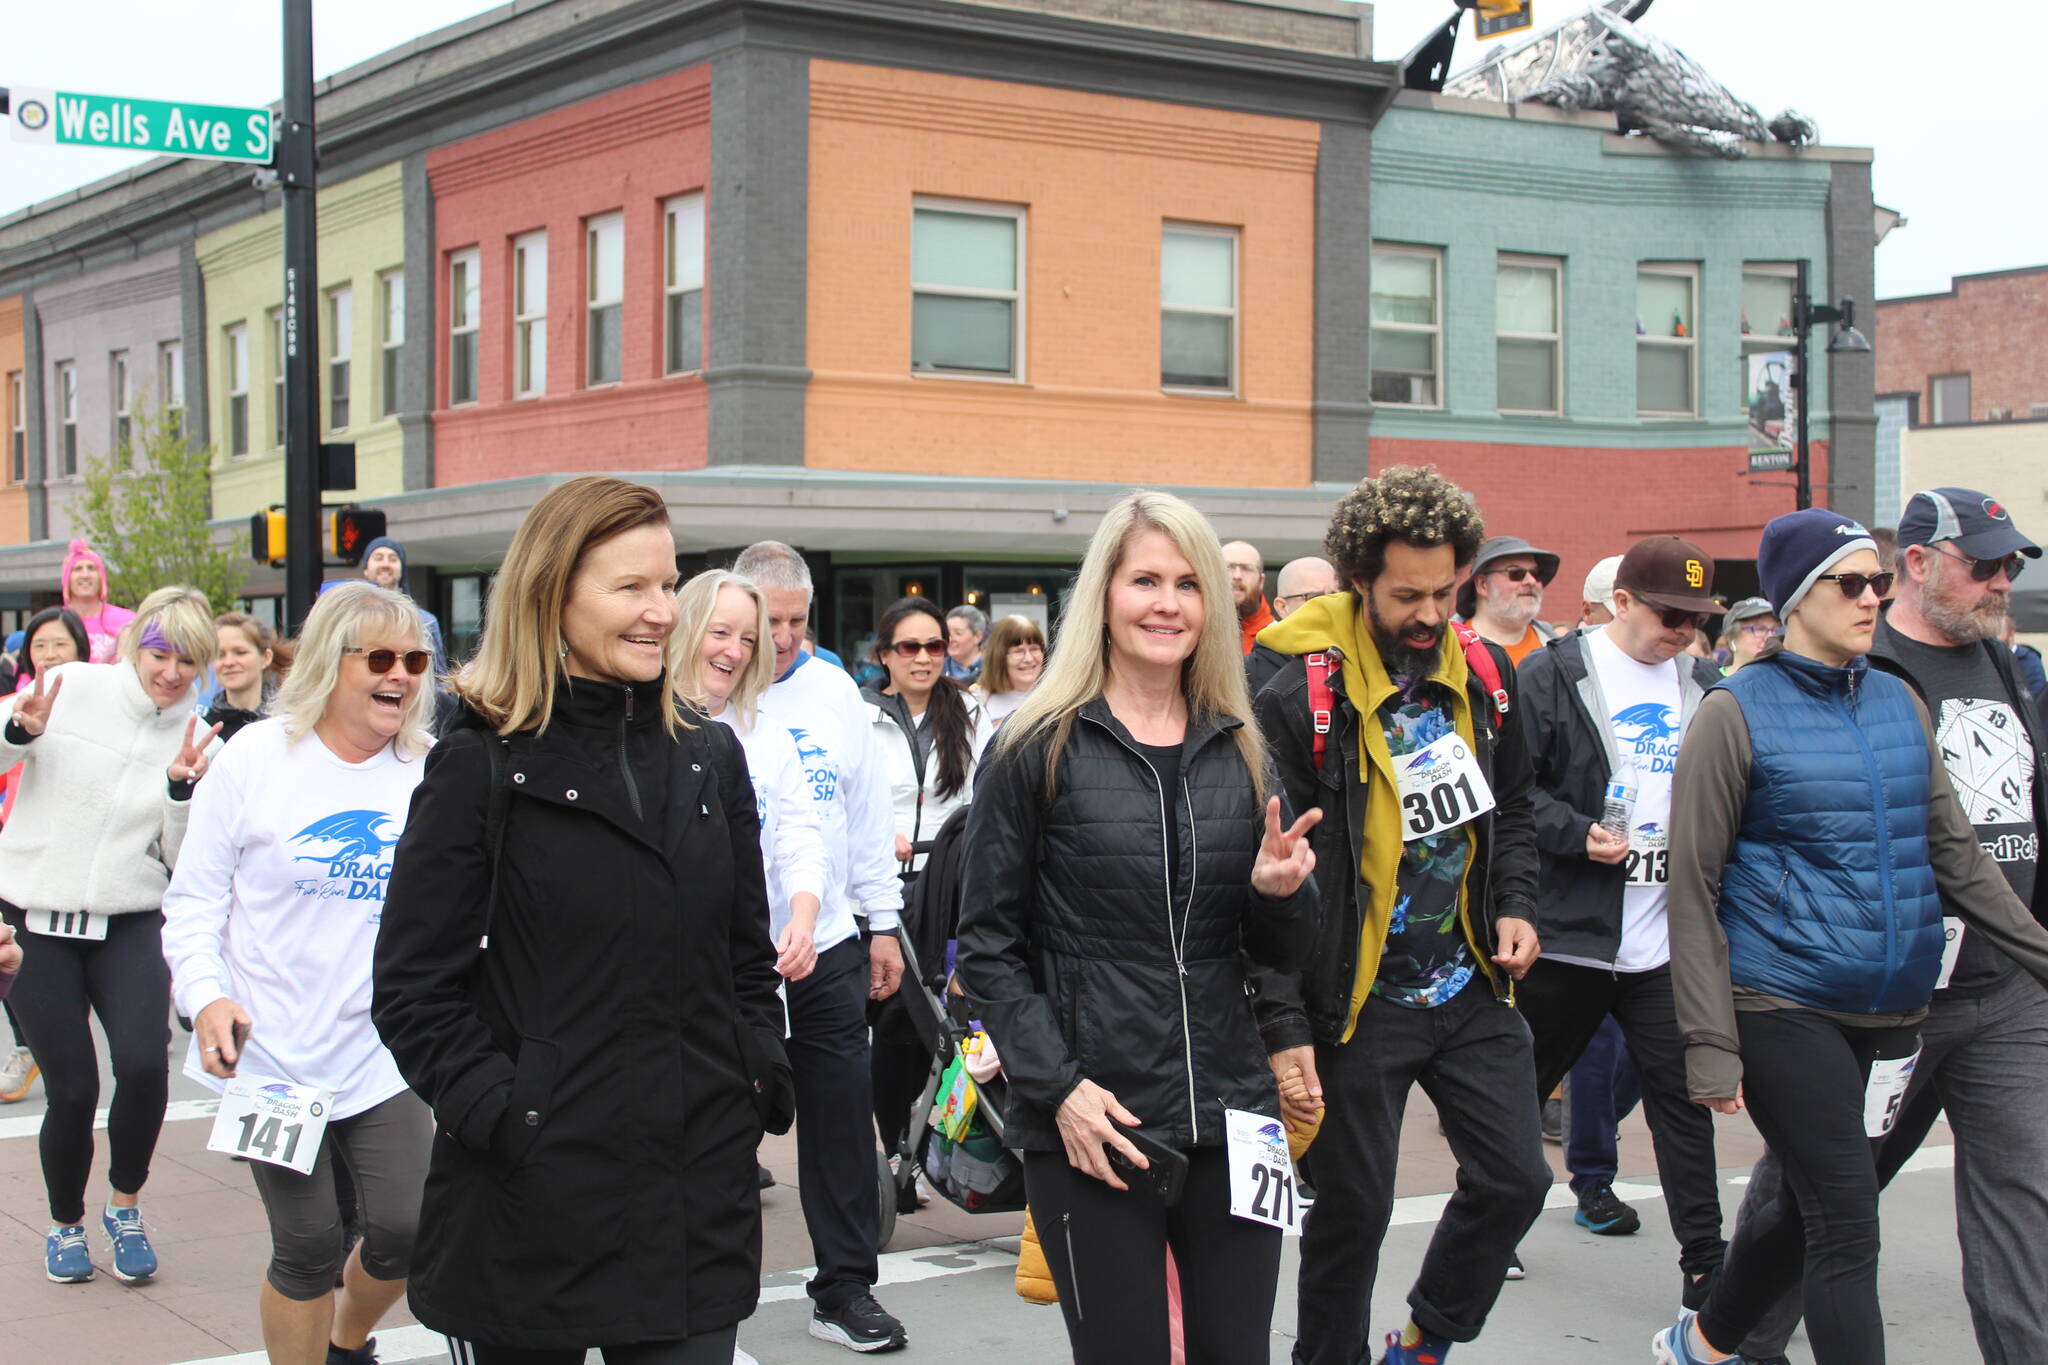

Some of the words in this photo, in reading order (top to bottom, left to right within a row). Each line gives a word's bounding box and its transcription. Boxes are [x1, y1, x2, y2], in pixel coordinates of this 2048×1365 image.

[59, 97, 149, 146] Wells
[164, 108, 232, 152] Ave
[245, 114, 268, 155] S
[1402, 772, 1479, 834] 301
[328, 861, 392, 880] DRAG
[346, 880, 386, 901] DA
[1625, 849, 1669, 883] 213
[237, 1112, 304, 1163] 141
[1251, 1163, 1294, 1227] 271
